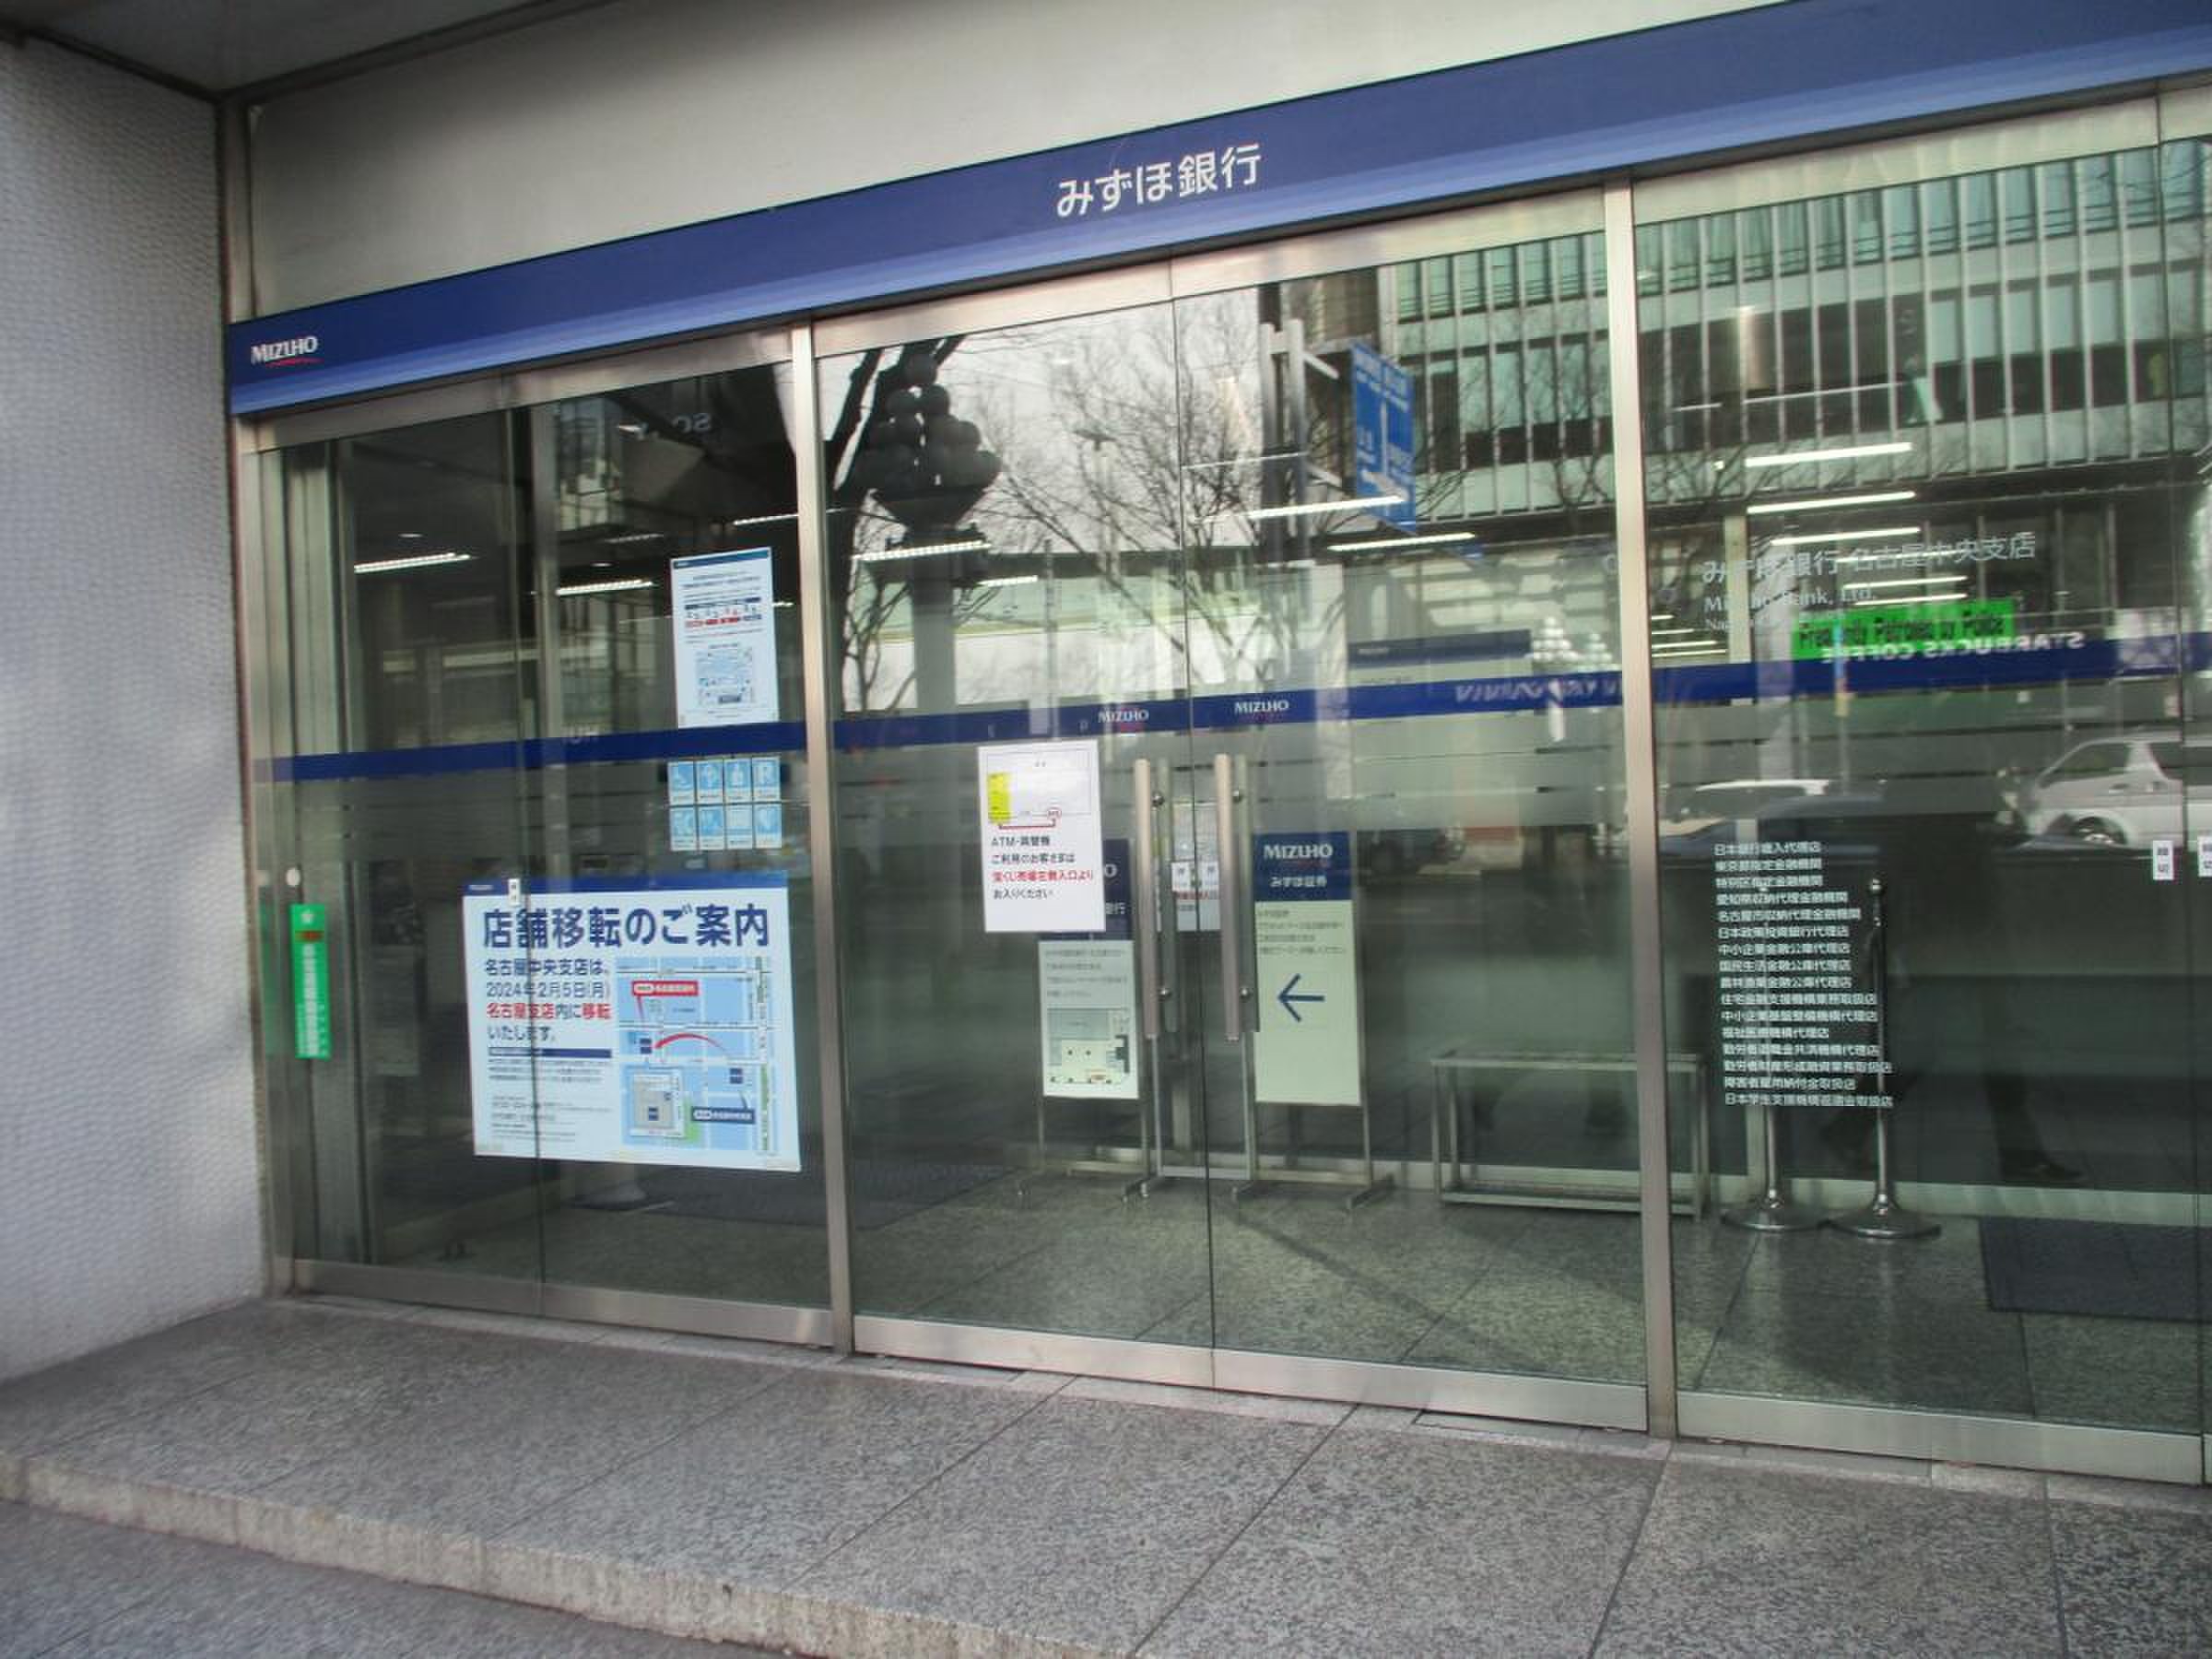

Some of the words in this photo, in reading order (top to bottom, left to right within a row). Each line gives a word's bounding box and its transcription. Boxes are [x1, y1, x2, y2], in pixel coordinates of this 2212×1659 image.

[1056, 143, 1261, 218] みずほ銀行
[250, 335, 318, 365] MIZUHO
[1098, 708, 1149, 724] MIZUHO
[1234, 699, 1289, 714] MIZUHO
[1263, 843, 1334, 860] MIZUHO
[483, 903, 770, 949] 店舗移転のご案内
